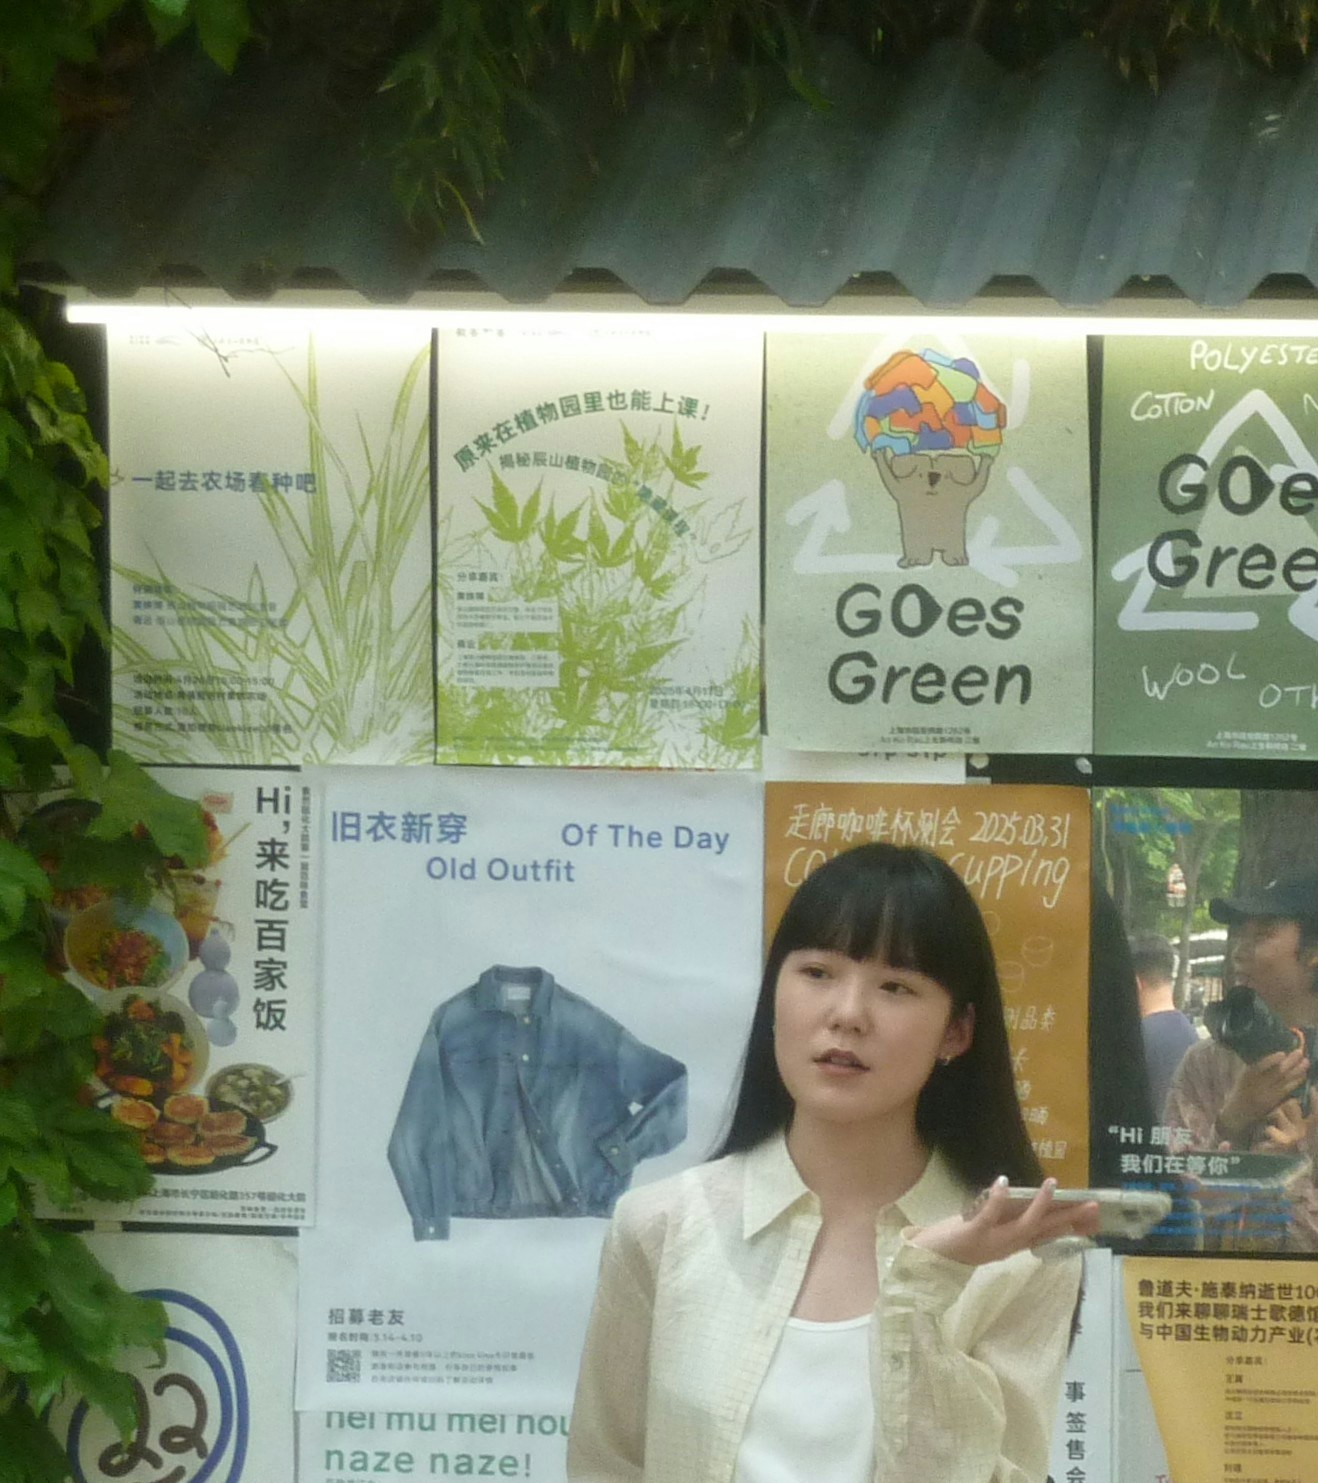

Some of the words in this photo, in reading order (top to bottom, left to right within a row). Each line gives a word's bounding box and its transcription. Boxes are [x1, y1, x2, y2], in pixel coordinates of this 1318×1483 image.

[131, 469, 317, 494] 一起去农场春种吧
[828, 650, 1032, 706] Green
[1142, 653, 1246, 700] WOOL
[331, 811, 467, 845] 旧衣新穿
[562, 823, 597, 847] Of
[608, 824, 663, 849] The
[674, 826, 730, 855] Day
[426, 856, 476, 881] Old
[487, 857, 575, 883] Outfit
[1150, 1126, 1194, 1146] 朋友
[328, 1307, 404, 1326] 招募老友
[386, 1411, 436, 1432] mu
[324, 1449, 414, 1473] naze
[430, 1451, 531, 1478] naze!
